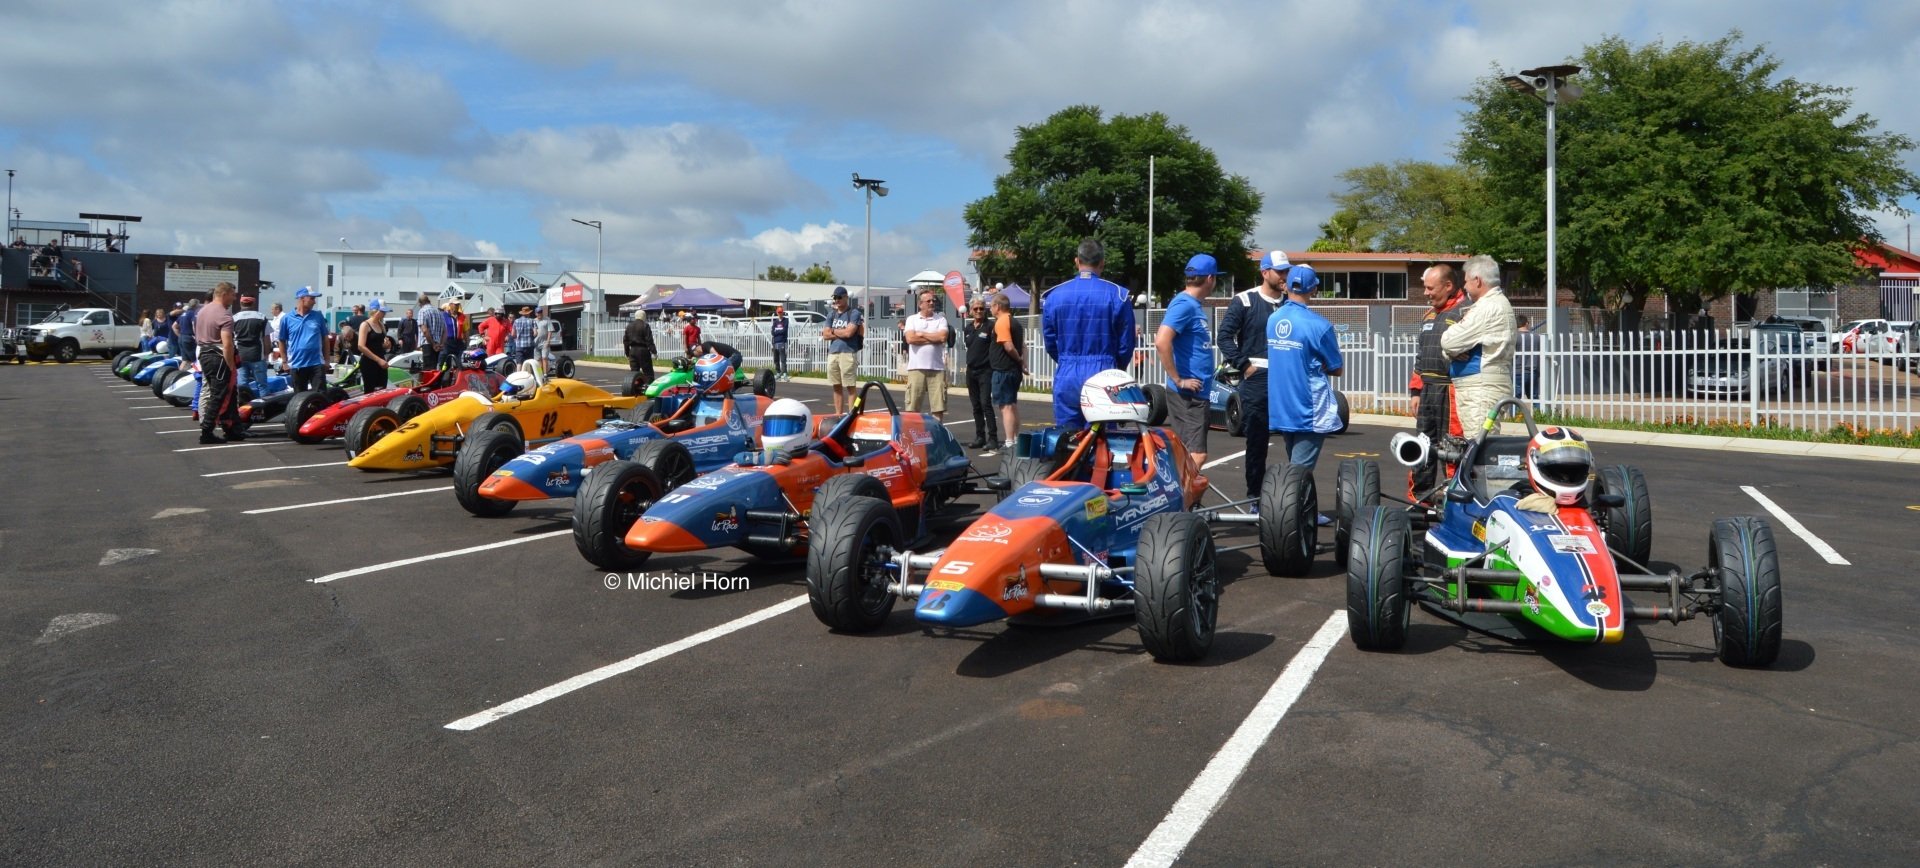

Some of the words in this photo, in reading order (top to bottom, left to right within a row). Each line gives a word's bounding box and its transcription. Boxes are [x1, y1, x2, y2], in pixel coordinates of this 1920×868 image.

[702, 370, 718, 382] 33
[540, 410, 558, 437] 92
[660, 494, 692, 504] 11
[1115, 493, 1169, 527] MANGAZA
[722, 519, 739, 534] Race
[939, 560, 975, 575] 5
